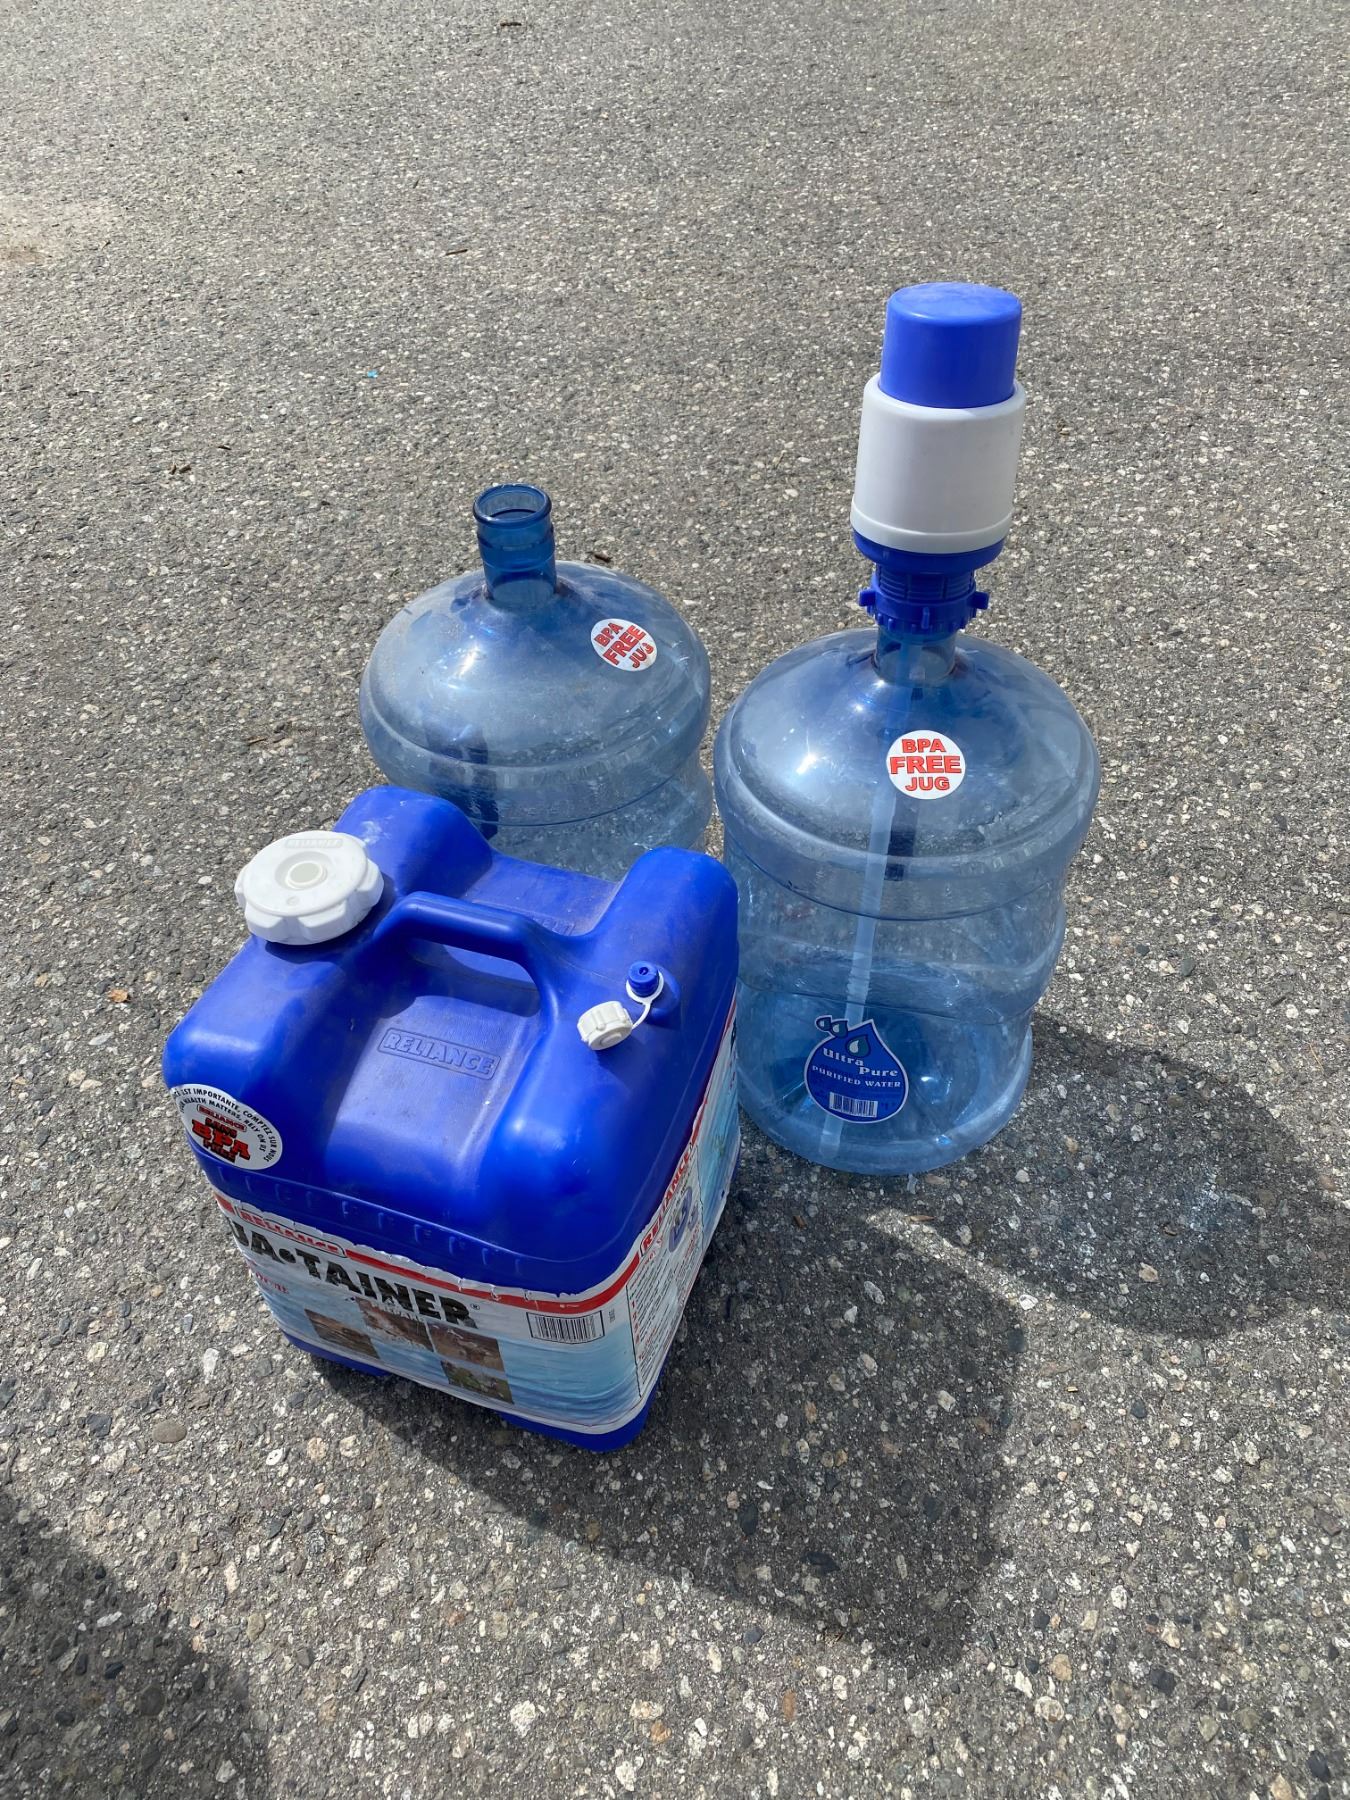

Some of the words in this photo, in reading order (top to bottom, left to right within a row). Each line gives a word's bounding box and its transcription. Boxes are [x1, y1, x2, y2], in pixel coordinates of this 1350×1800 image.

[594, 623, 624, 647] BPA
[602, 625, 647, 665] FREE
[629, 642, 654, 668] JUG
[901, 738, 947, 753] BPA
[890, 755, 962, 775] FREE
[905, 776, 950, 791] JUG
[384, 1033, 495, 1075] RELIANCE
[823, 1047, 864, 1067] Ultra
[812, 1065, 861, 1085] PURIFIED
[858, 1066, 899, 1077] Pure
[865, 1080, 901, 1088] WATER
[193, 1088, 240, 1113] IMPORTANTE,
[243, 1110, 272, 1136] COMPTEZ
[208, 1099, 241, 1121] MATTERS,
[243, 1119, 261, 1133] RELY
[192, 1119, 250, 1161] BPA
